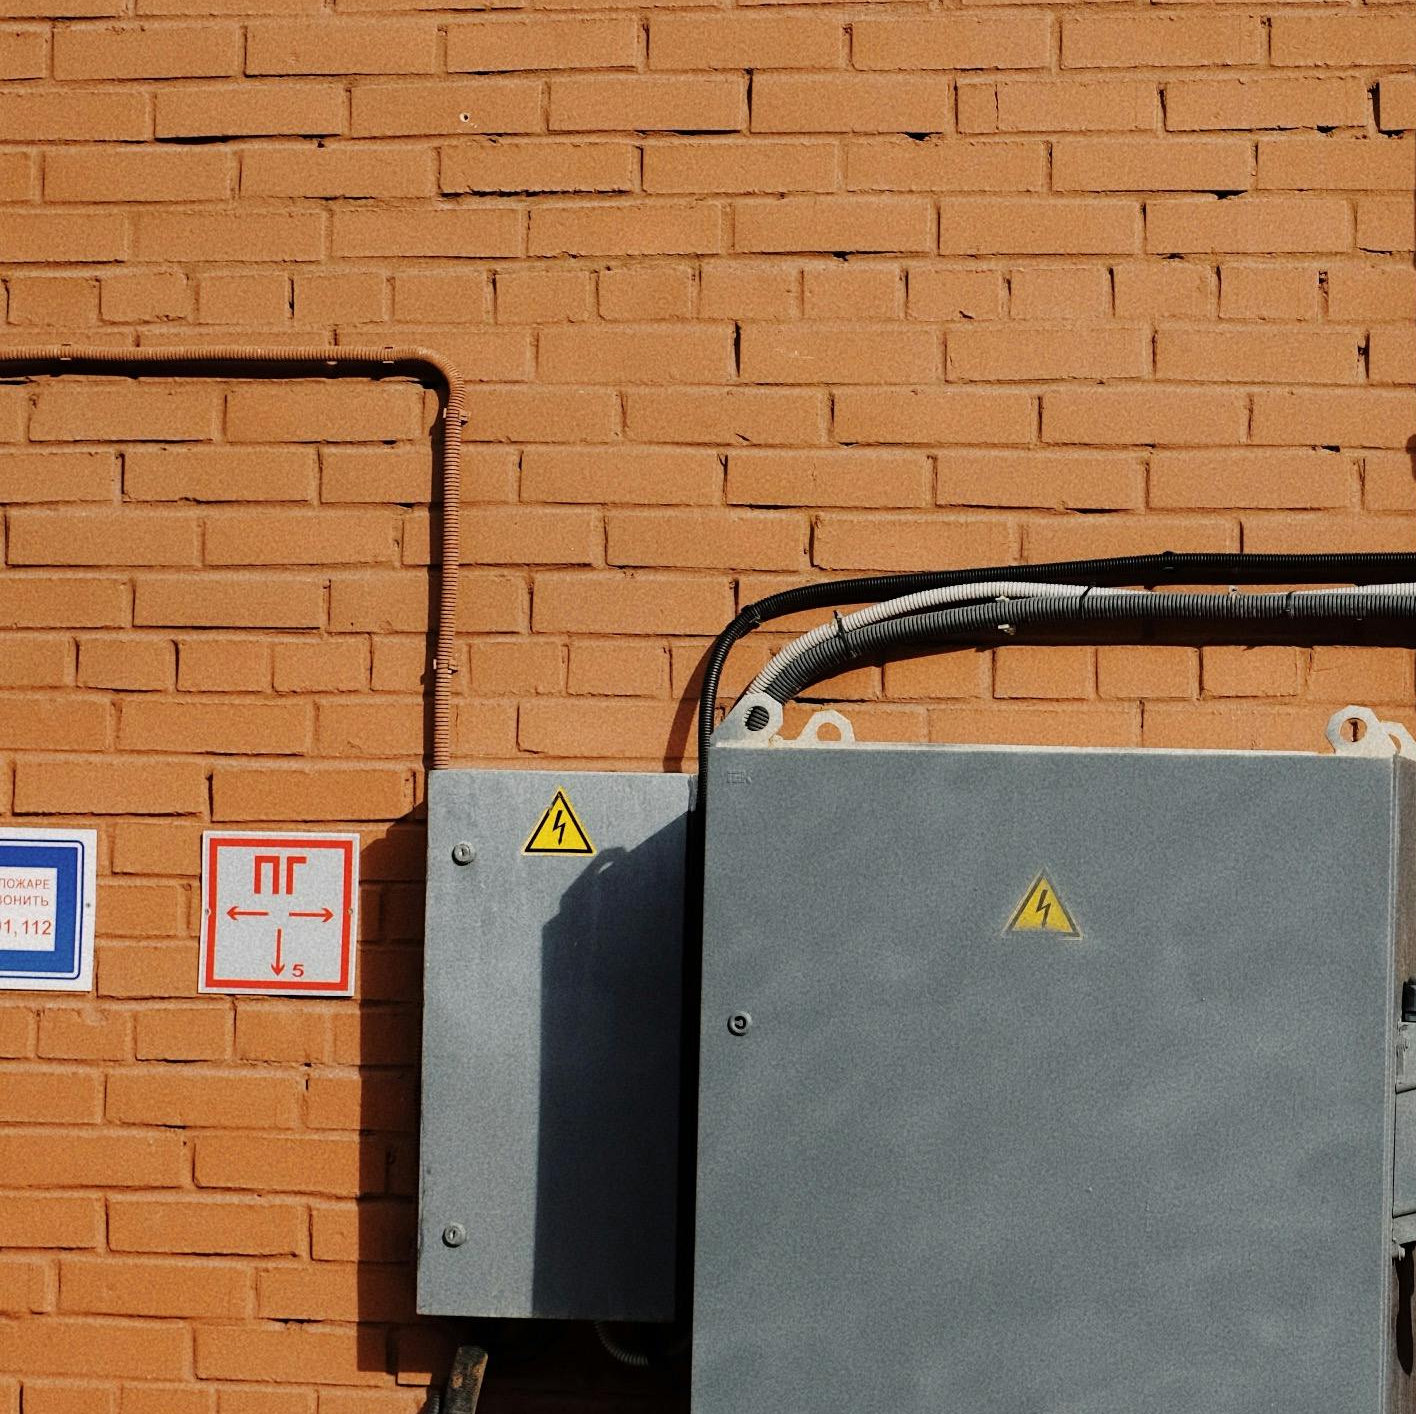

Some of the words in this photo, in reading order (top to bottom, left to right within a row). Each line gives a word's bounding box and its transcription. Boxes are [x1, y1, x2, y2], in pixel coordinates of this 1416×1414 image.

[253, 855, 307, 895] ПГ
[0, 895, 49, 906] ОНИТЬ
[292, 964, 304, 977] 5
